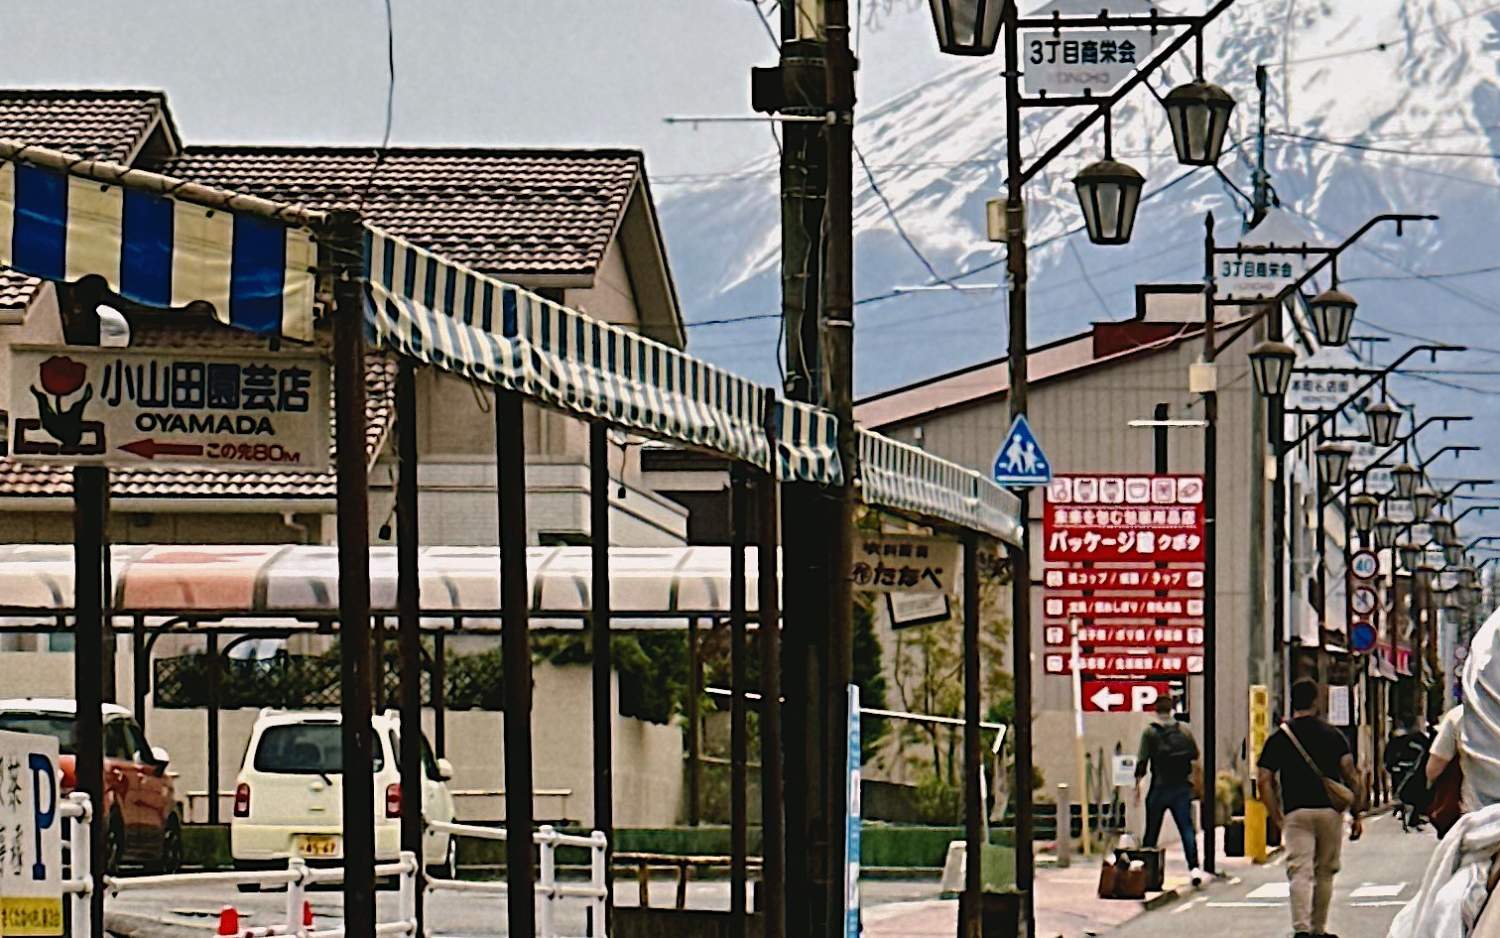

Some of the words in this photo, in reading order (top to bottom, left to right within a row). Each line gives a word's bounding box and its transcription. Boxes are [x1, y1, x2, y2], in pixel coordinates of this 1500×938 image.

[1030, 40, 1136, 64] 3丁目商栄会
[135, 413, 275, 435] OYAMADA
[1356, 559, 1373, 573] 40
[1131, 685, 1159, 712] P
[28, 752, 57, 881] P
